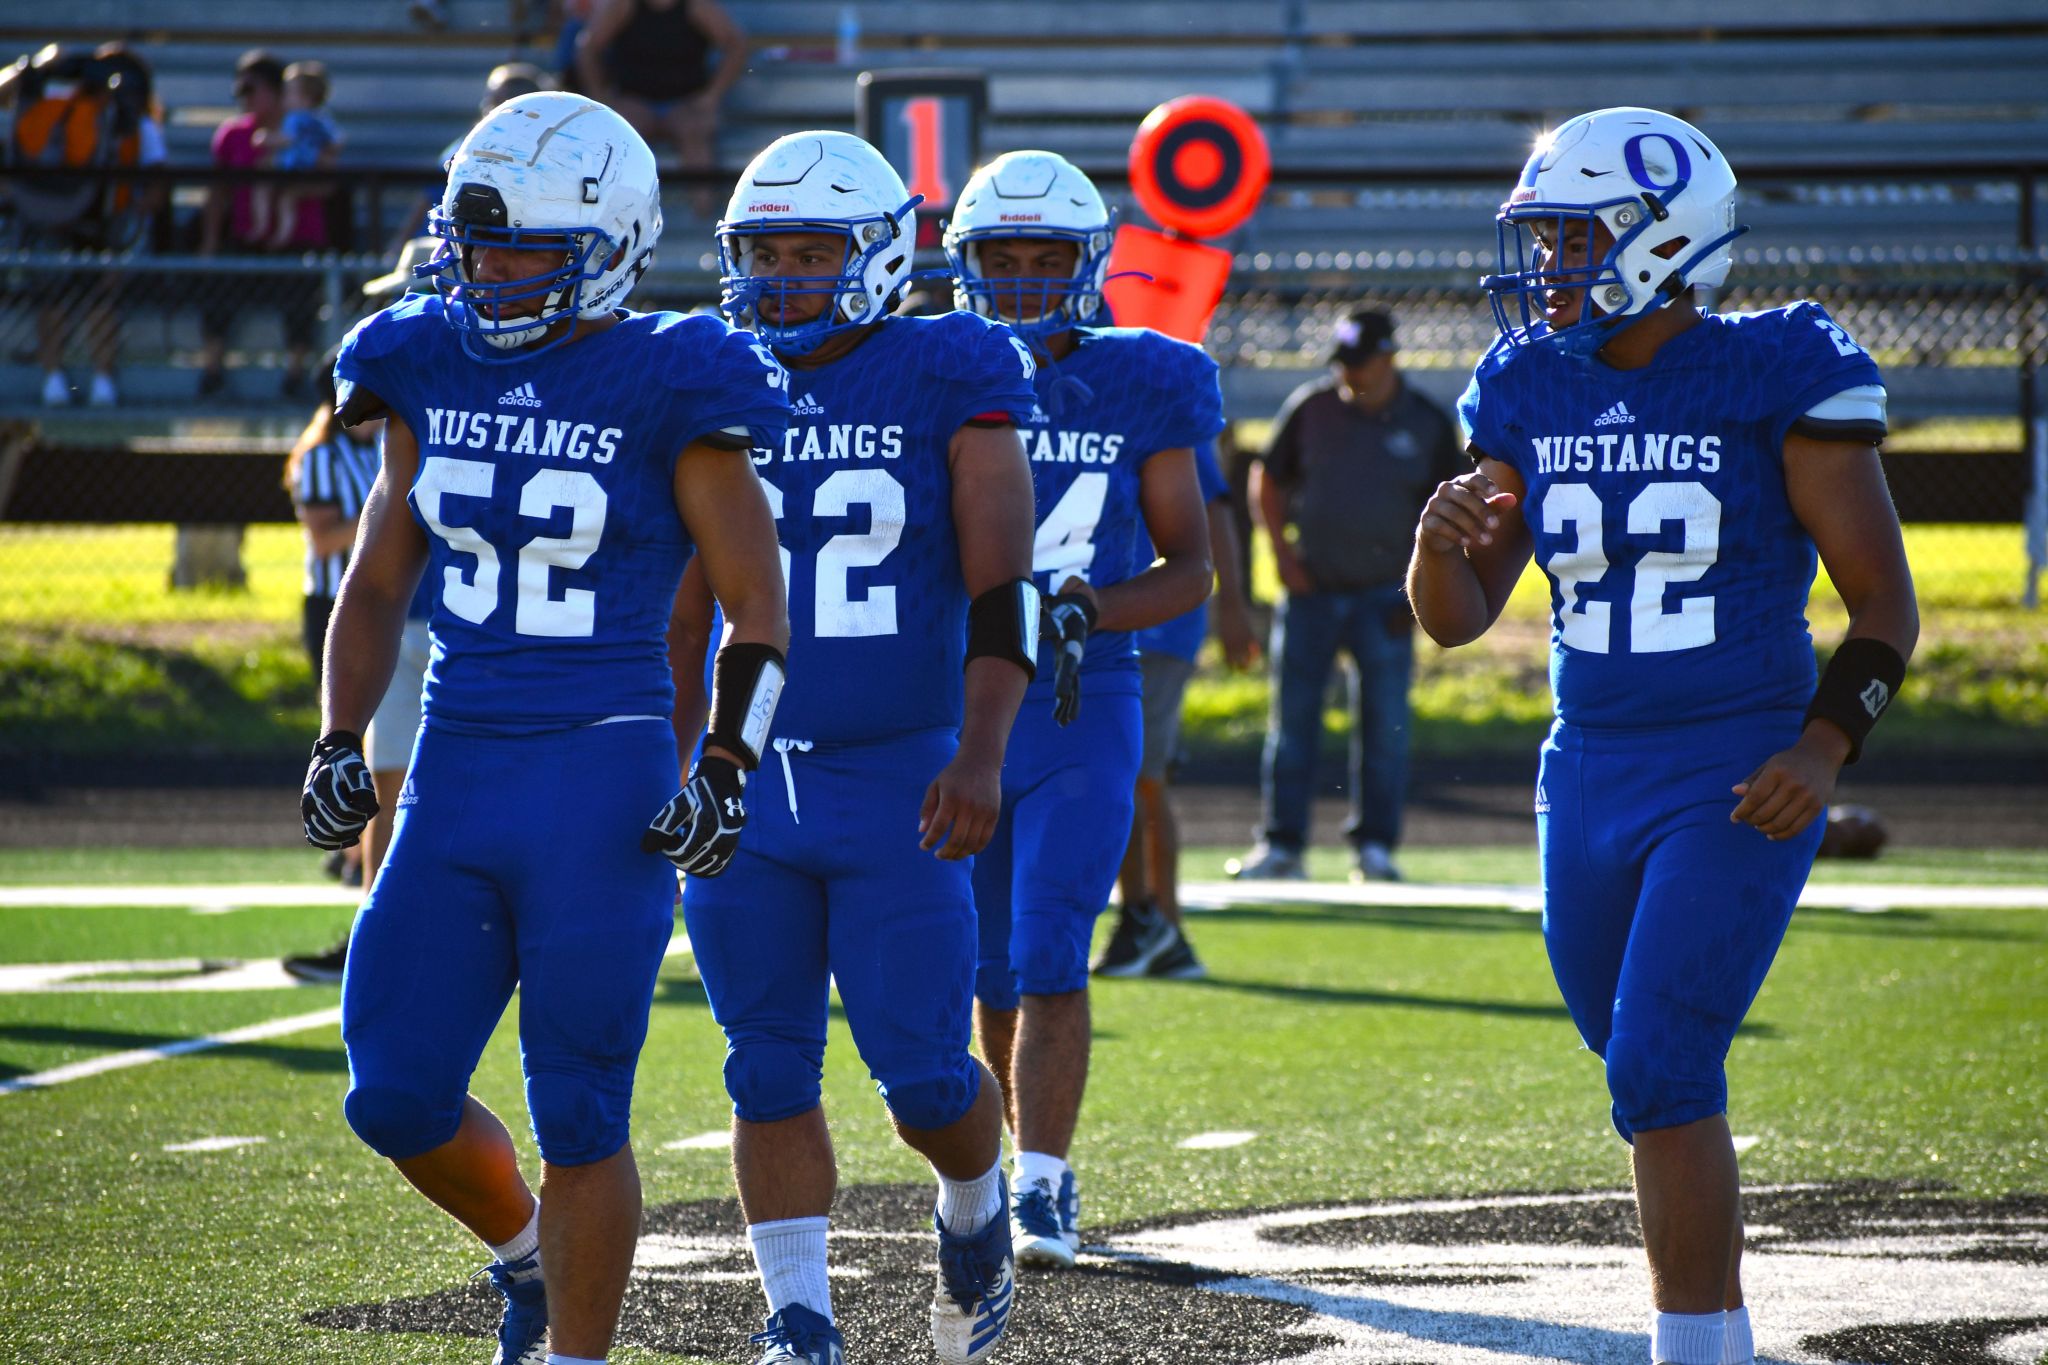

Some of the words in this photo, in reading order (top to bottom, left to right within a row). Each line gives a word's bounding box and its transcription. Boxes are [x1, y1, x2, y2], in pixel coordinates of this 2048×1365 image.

[905, 97, 949, 208] 1
[1000, 214, 1042, 222] Riddell
[1009, 336, 1037, 381] 6
[1814, 319, 1869, 357] 2
[497, 395, 542, 408] adidas
[793, 405, 825, 416] didas
[1594, 412, 1636, 427] adidas
[425, 407, 623, 464] MUSTANGS
[1017, 429, 1124, 464] TANGS
[1532, 432, 1722, 474] MUSTANGS
[414, 456, 608, 637] 52
[1032, 471, 1109, 597] 4
[1542, 481, 1722, 654] 22
